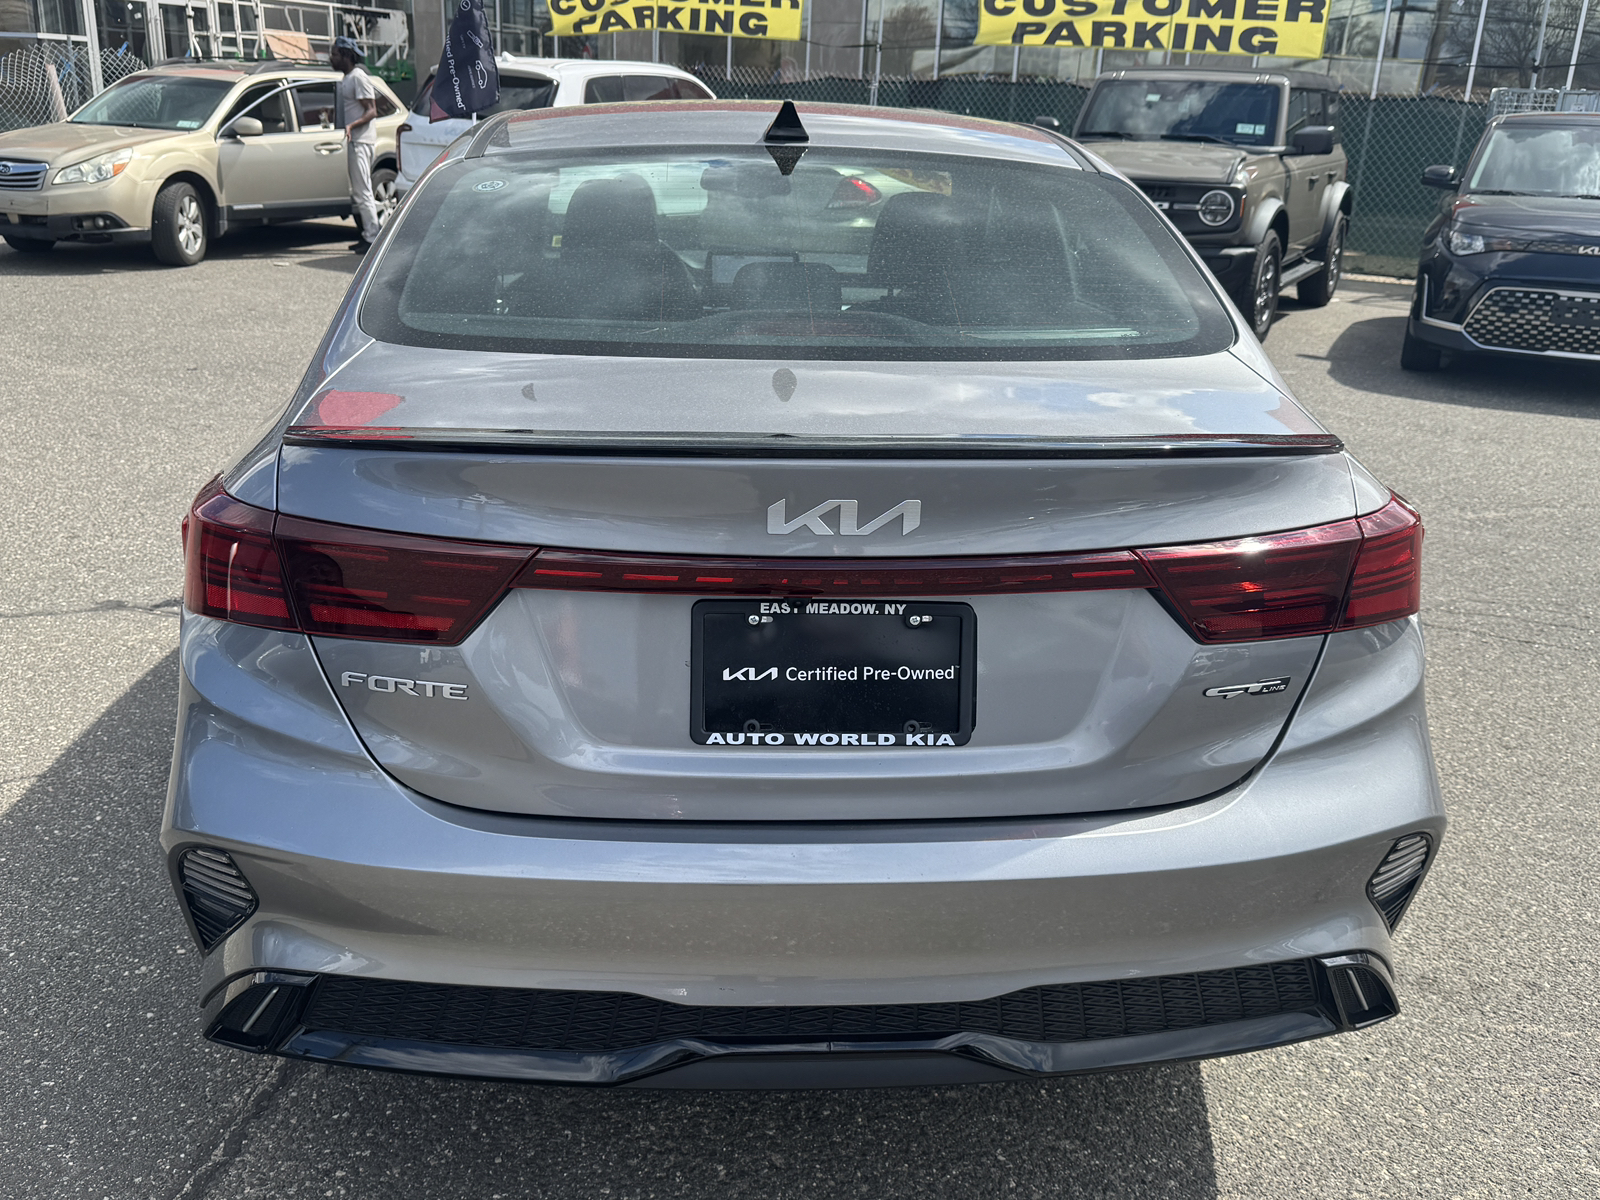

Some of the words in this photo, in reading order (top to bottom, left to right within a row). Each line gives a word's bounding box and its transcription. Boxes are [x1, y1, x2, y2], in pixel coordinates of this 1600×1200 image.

[573, 6, 768, 36] PARKING
[1012, 21, 1278, 54] PARKING
[1578, 246, 1600, 255] KI
[767, 498, 921, 535] KIA
[884, 603, 907, 615] NY
[722, 667, 778, 681] KIA
[786, 667, 857, 681] Certified
[864, 666, 954, 680] Pre-Owned
[341, 671, 468, 700] FORTE
[1262, 684, 1286, 693] LINE
[706, 733, 785, 746] AUTO
[794, 733, 896, 746] WORLD
[906, 733, 956, 746] KIA
